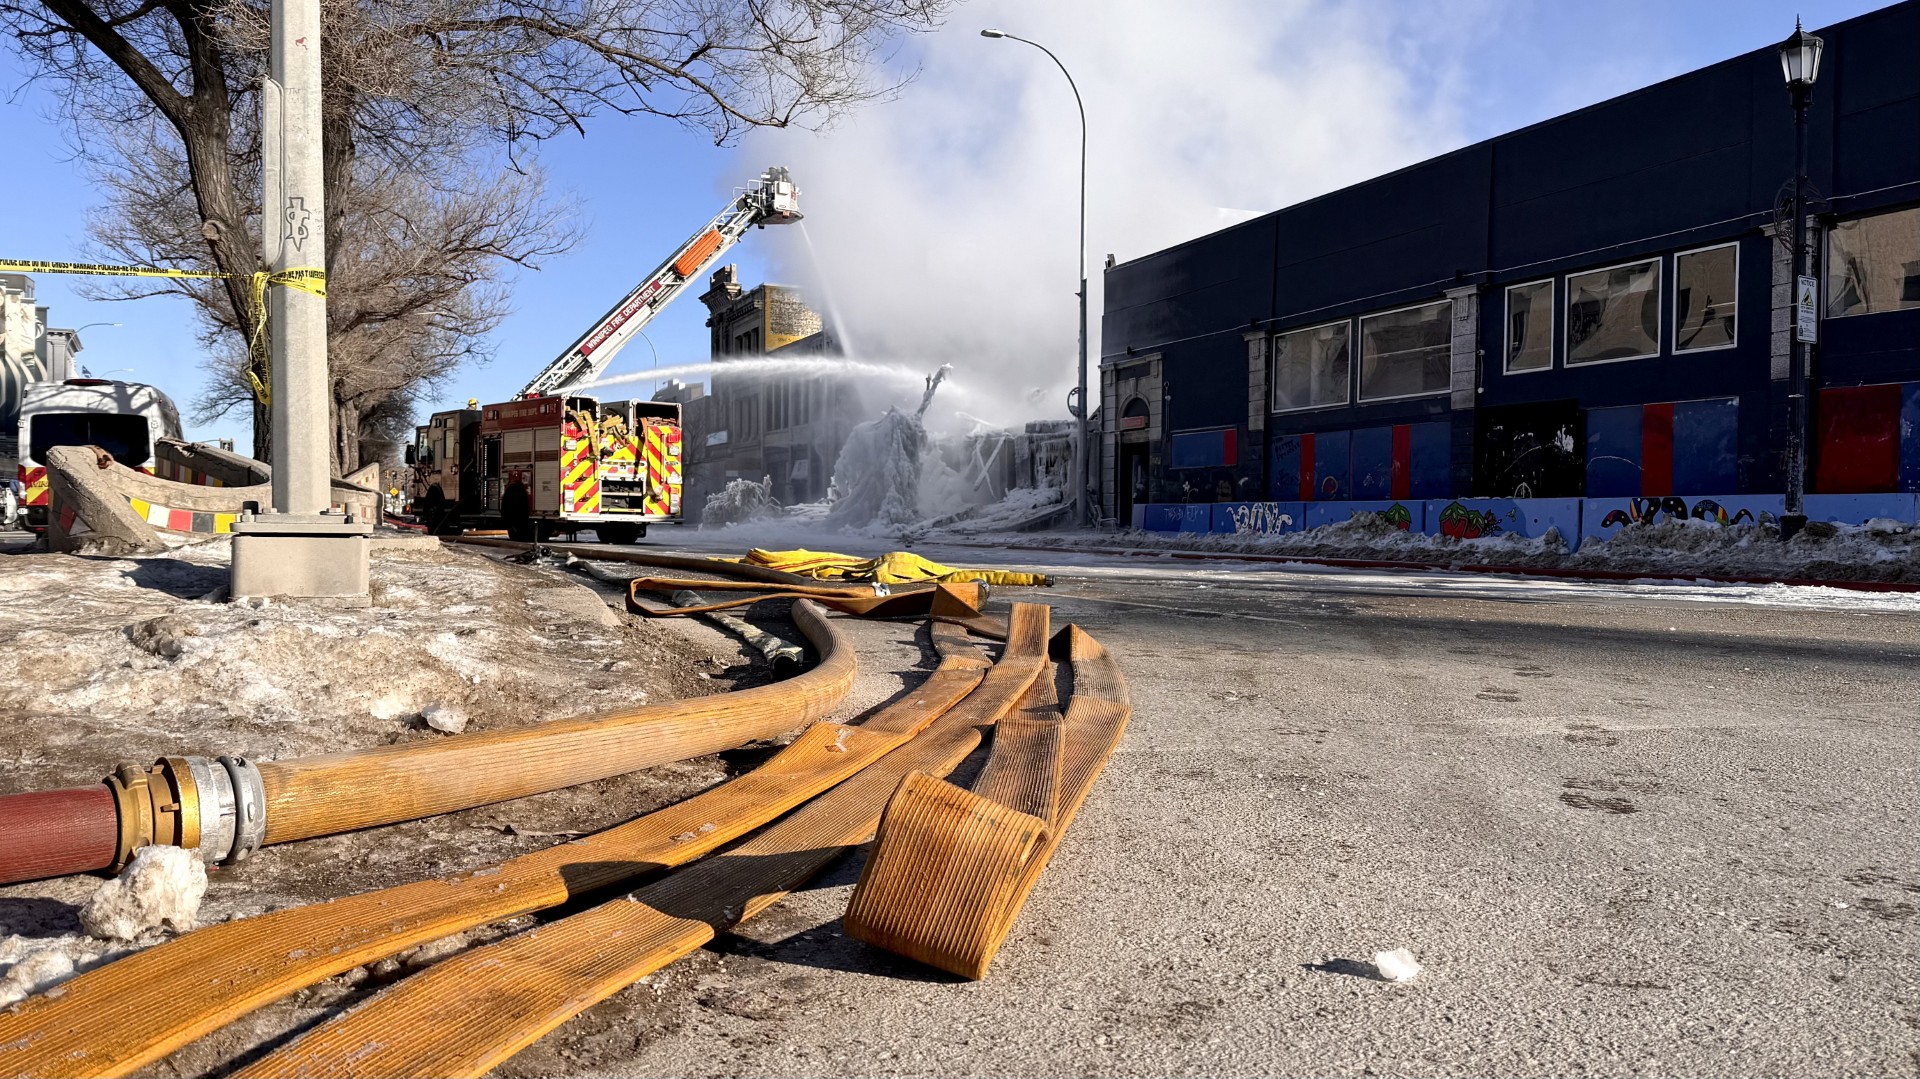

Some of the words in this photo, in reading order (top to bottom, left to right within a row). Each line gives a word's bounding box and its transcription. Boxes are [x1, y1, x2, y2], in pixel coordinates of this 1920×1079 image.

[1801, 279, 1815, 288] NOTICE
[585, 325, 614, 350] WINNIPEG
[611, 314, 625, 328] FIRE
[622, 286, 656, 317] DEPARTMENT
